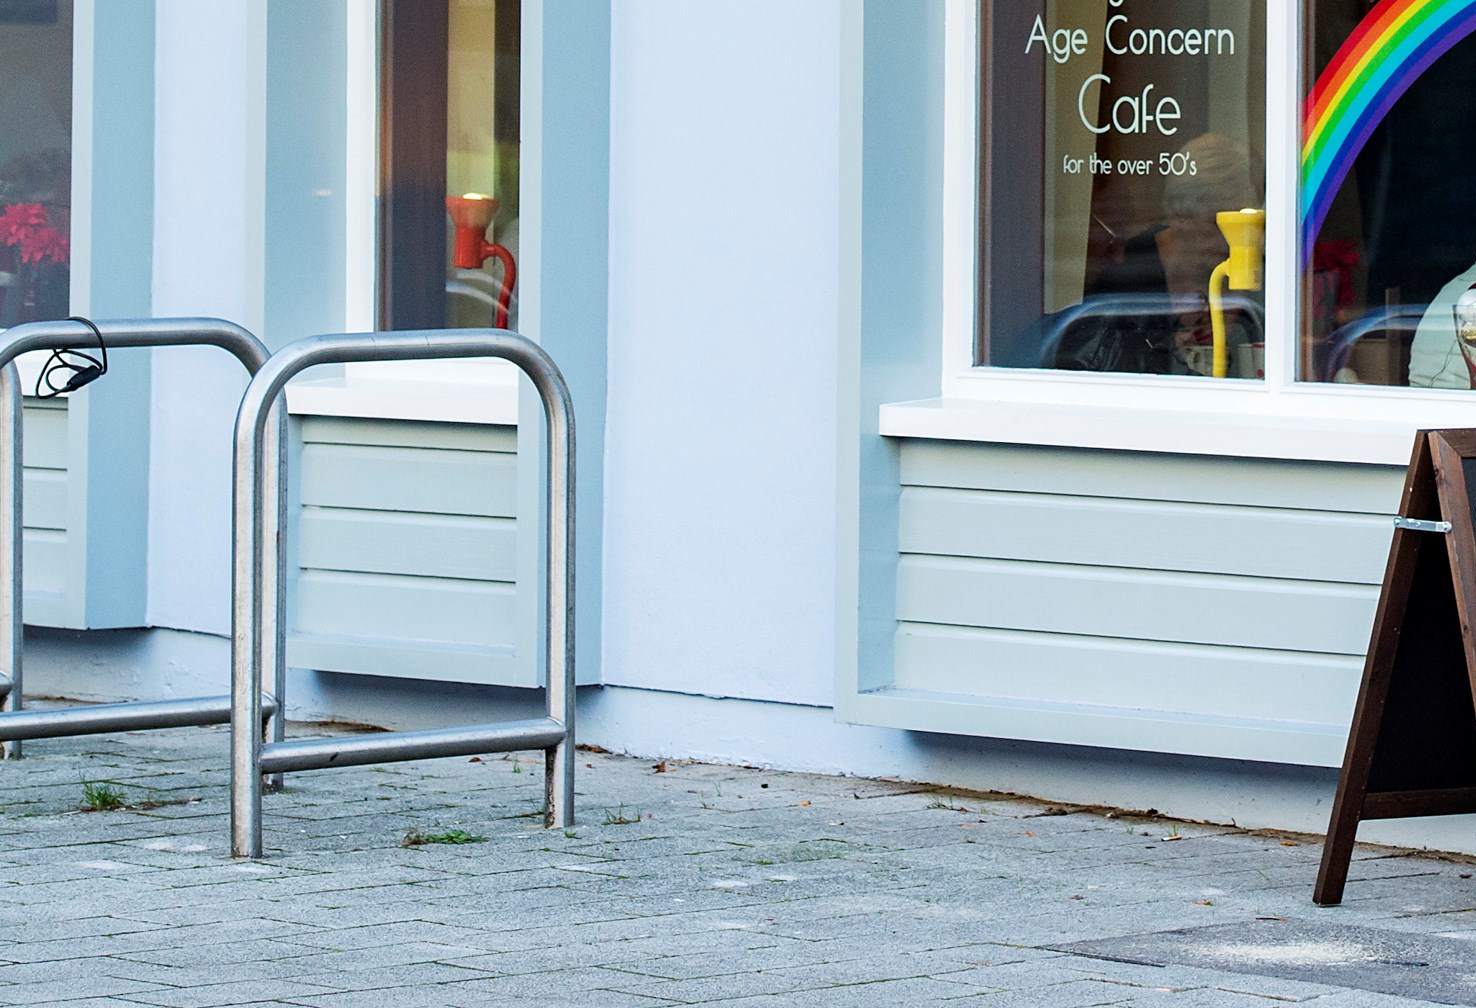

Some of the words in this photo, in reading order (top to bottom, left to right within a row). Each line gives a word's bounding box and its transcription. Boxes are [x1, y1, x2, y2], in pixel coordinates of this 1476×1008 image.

[1024, 14, 1088, 64] Age
[1105, 14, 1235, 55] Concern
[1078, 73, 1181, 136] Cafe
[1063, 154, 1084, 174] for
[1089, 152, 1112, 175] the
[1117, 157, 1153, 175] over
[1158, 152, 1197, 176] 50's
